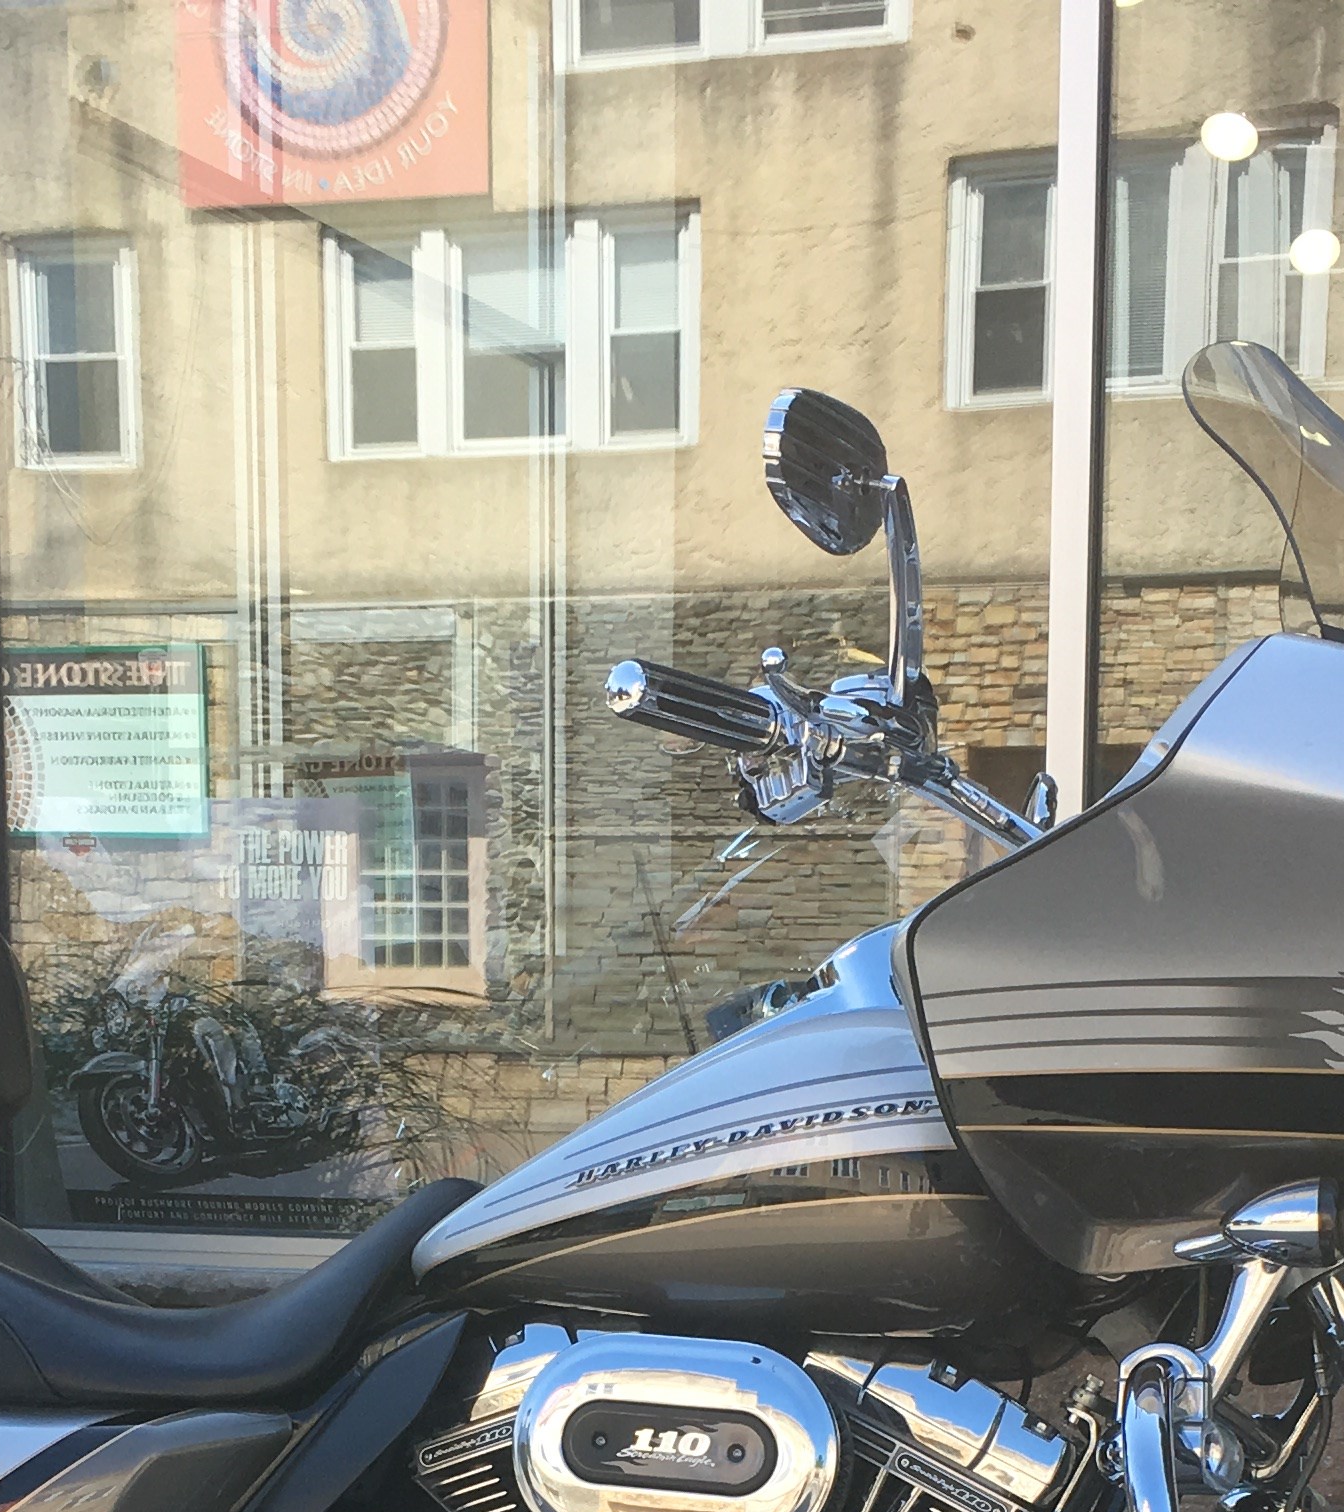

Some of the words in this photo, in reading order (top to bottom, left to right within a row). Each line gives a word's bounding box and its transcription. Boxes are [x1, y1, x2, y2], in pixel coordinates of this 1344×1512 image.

[238, 829, 272, 864] THE
[278, 830, 348, 865] POWER
[218, 865, 241, 900] TO
[247, 865, 302, 900] MOVE
[308, 866, 348, 901] YOU
[634, 1428, 712, 1457] 110
